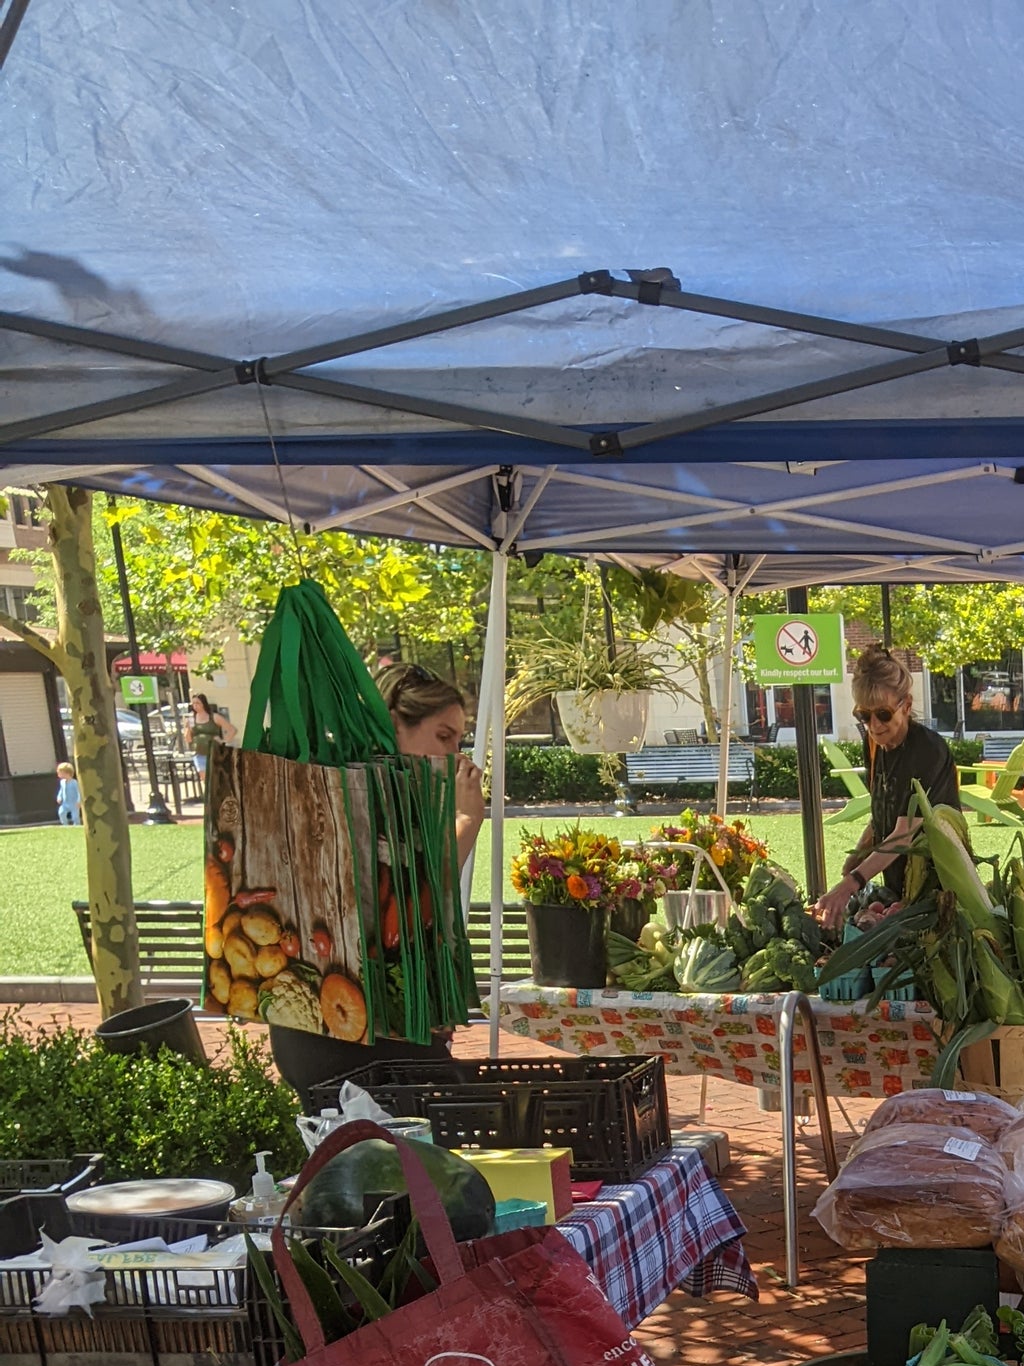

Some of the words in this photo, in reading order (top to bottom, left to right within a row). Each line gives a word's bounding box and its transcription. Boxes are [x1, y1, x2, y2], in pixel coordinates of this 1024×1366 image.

[760, 668, 782, 678] Kindly
[783, 668, 809, 677] respect
[823, 668, 839, 677] turf.
[603, 1337, 637, 1361] enco
